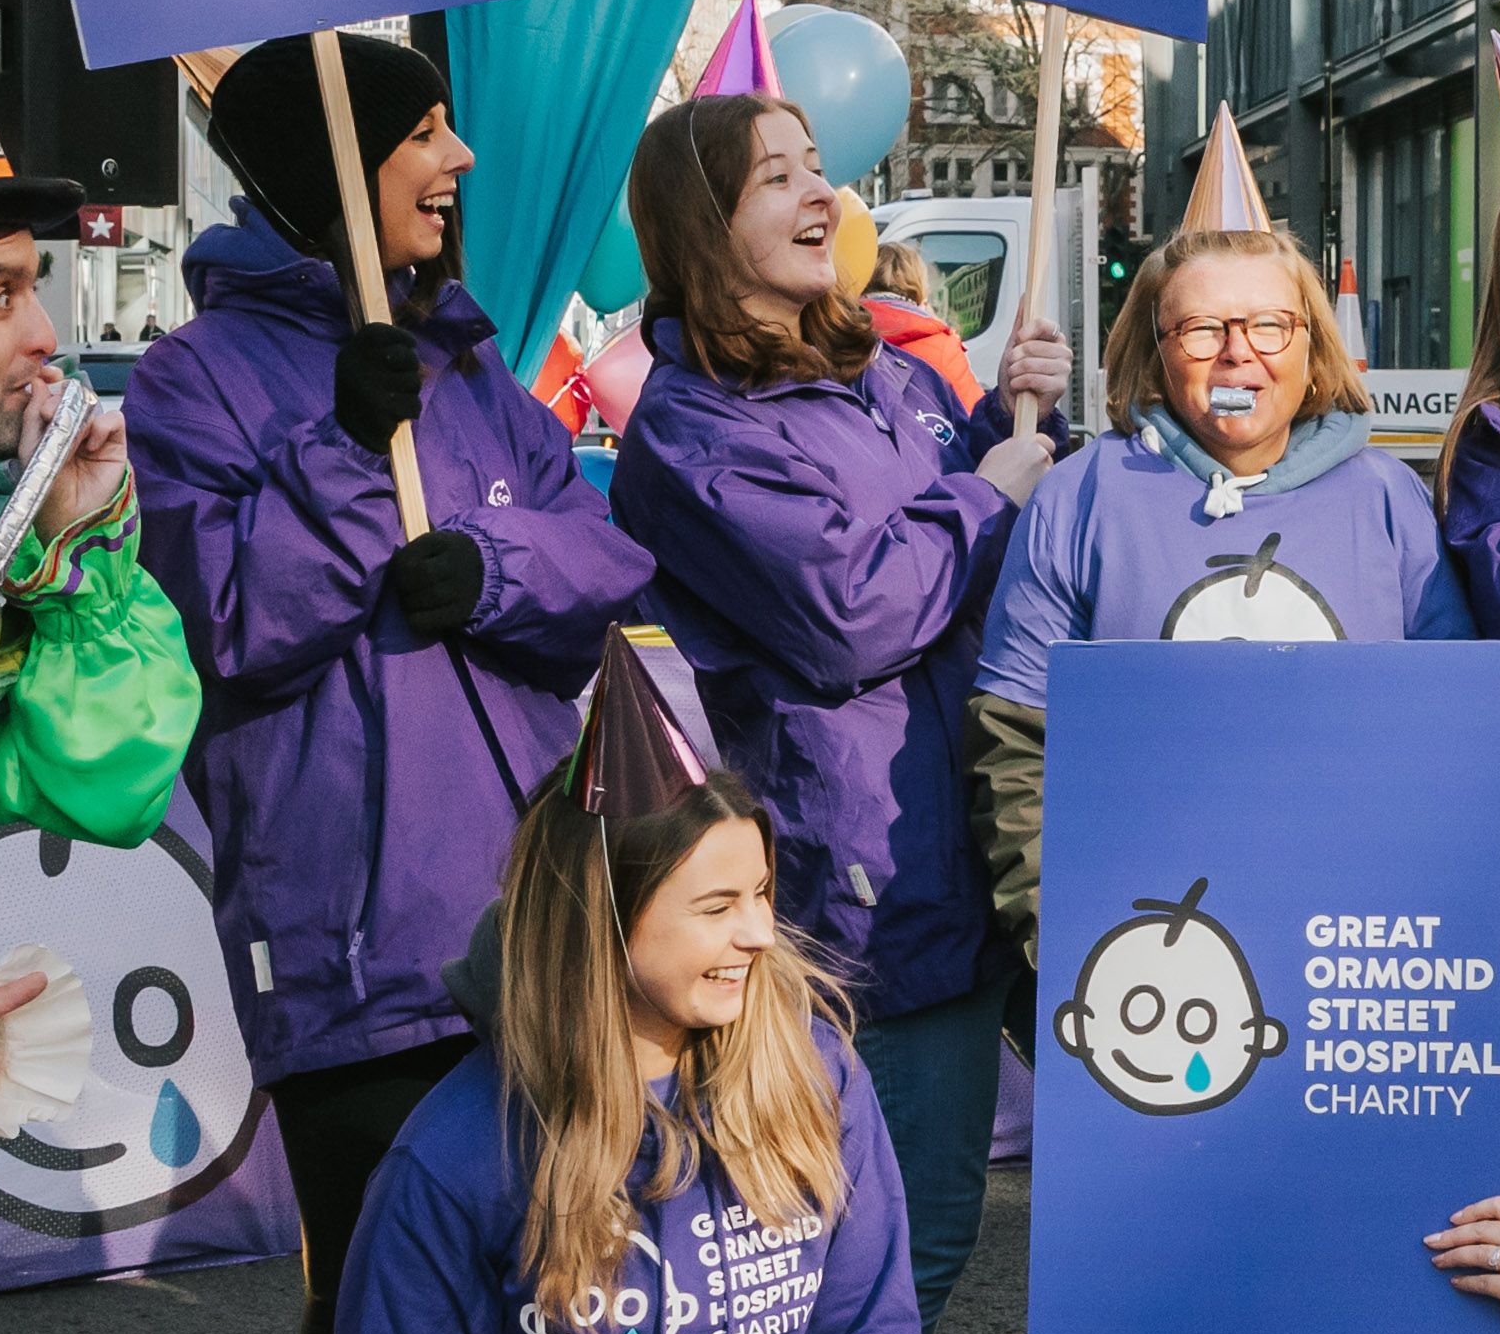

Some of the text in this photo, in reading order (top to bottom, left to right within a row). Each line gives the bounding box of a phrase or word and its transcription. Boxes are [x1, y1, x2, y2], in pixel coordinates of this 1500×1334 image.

[1306, 915, 1440, 948] GREAT
[1305, 956, 1493, 989] ORMOND
[1307, 998, 1455, 1031] STREET
[1305, 1083, 1470, 1116] CHARITY
